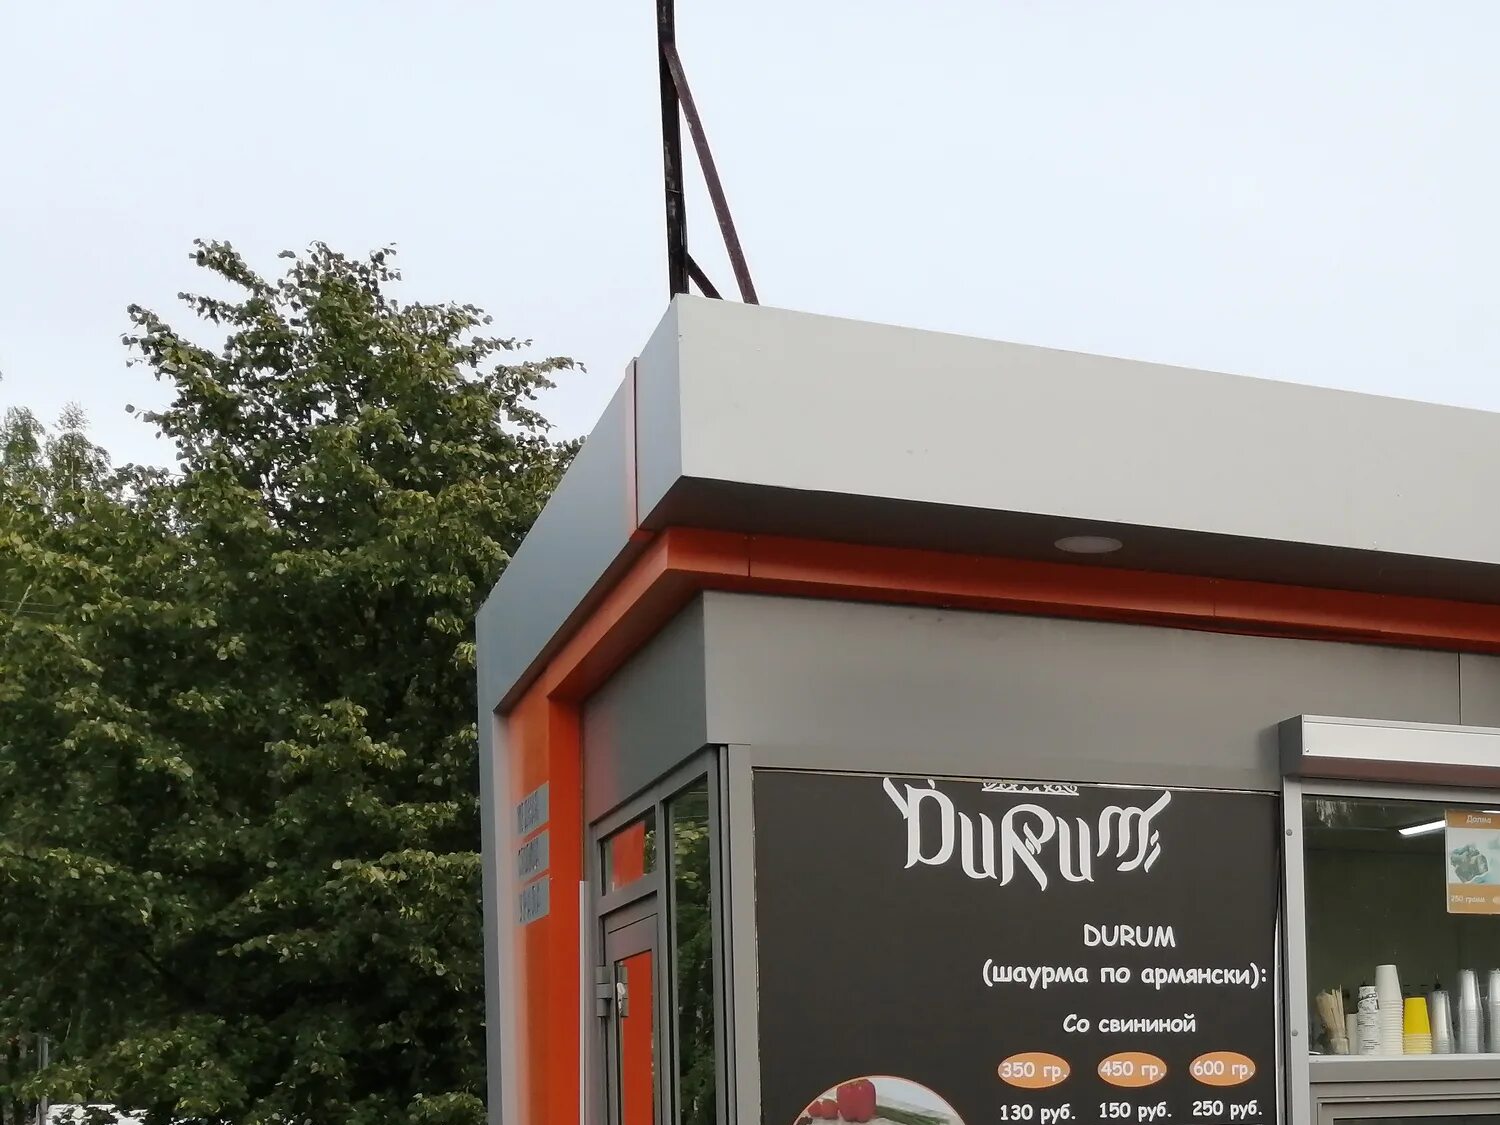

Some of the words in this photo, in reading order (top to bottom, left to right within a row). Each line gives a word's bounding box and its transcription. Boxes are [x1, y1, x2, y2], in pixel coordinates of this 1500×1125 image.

[1466, 815, 1492, 824] Долма
[1083, 924, 1175, 948] DURUM
[982, 959, 1089, 988] (шаурма
[1100, 966, 1128, 984] по
[1140, 962, 1267, 989] армянски):
[1062, 1013, 1090, 1033] Со
[1099, 1013, 1196, 1033] свининой
[1001, 1061, 1034, 1079] 350
[1043, 1063, 1068, 1085] гр.
[1100, 1060, 1133, 1077] 450
[1142, 1061, 1165, 1082] гр.
[1193, 1060, 1224, 1076] 600
[1231, 1061, 1255, 1081] гр.
[1000, 1103, 1033, 1121] 130
[1040, 1101, 1076, 1124] руб.
[1099, 1102, 1130, 1119] 150
[1137, 1101, 1172, 1123] руб.
[1192, 1100, 1224, 1117] 250
[1230, 1099, 1263, 1121] руб.
